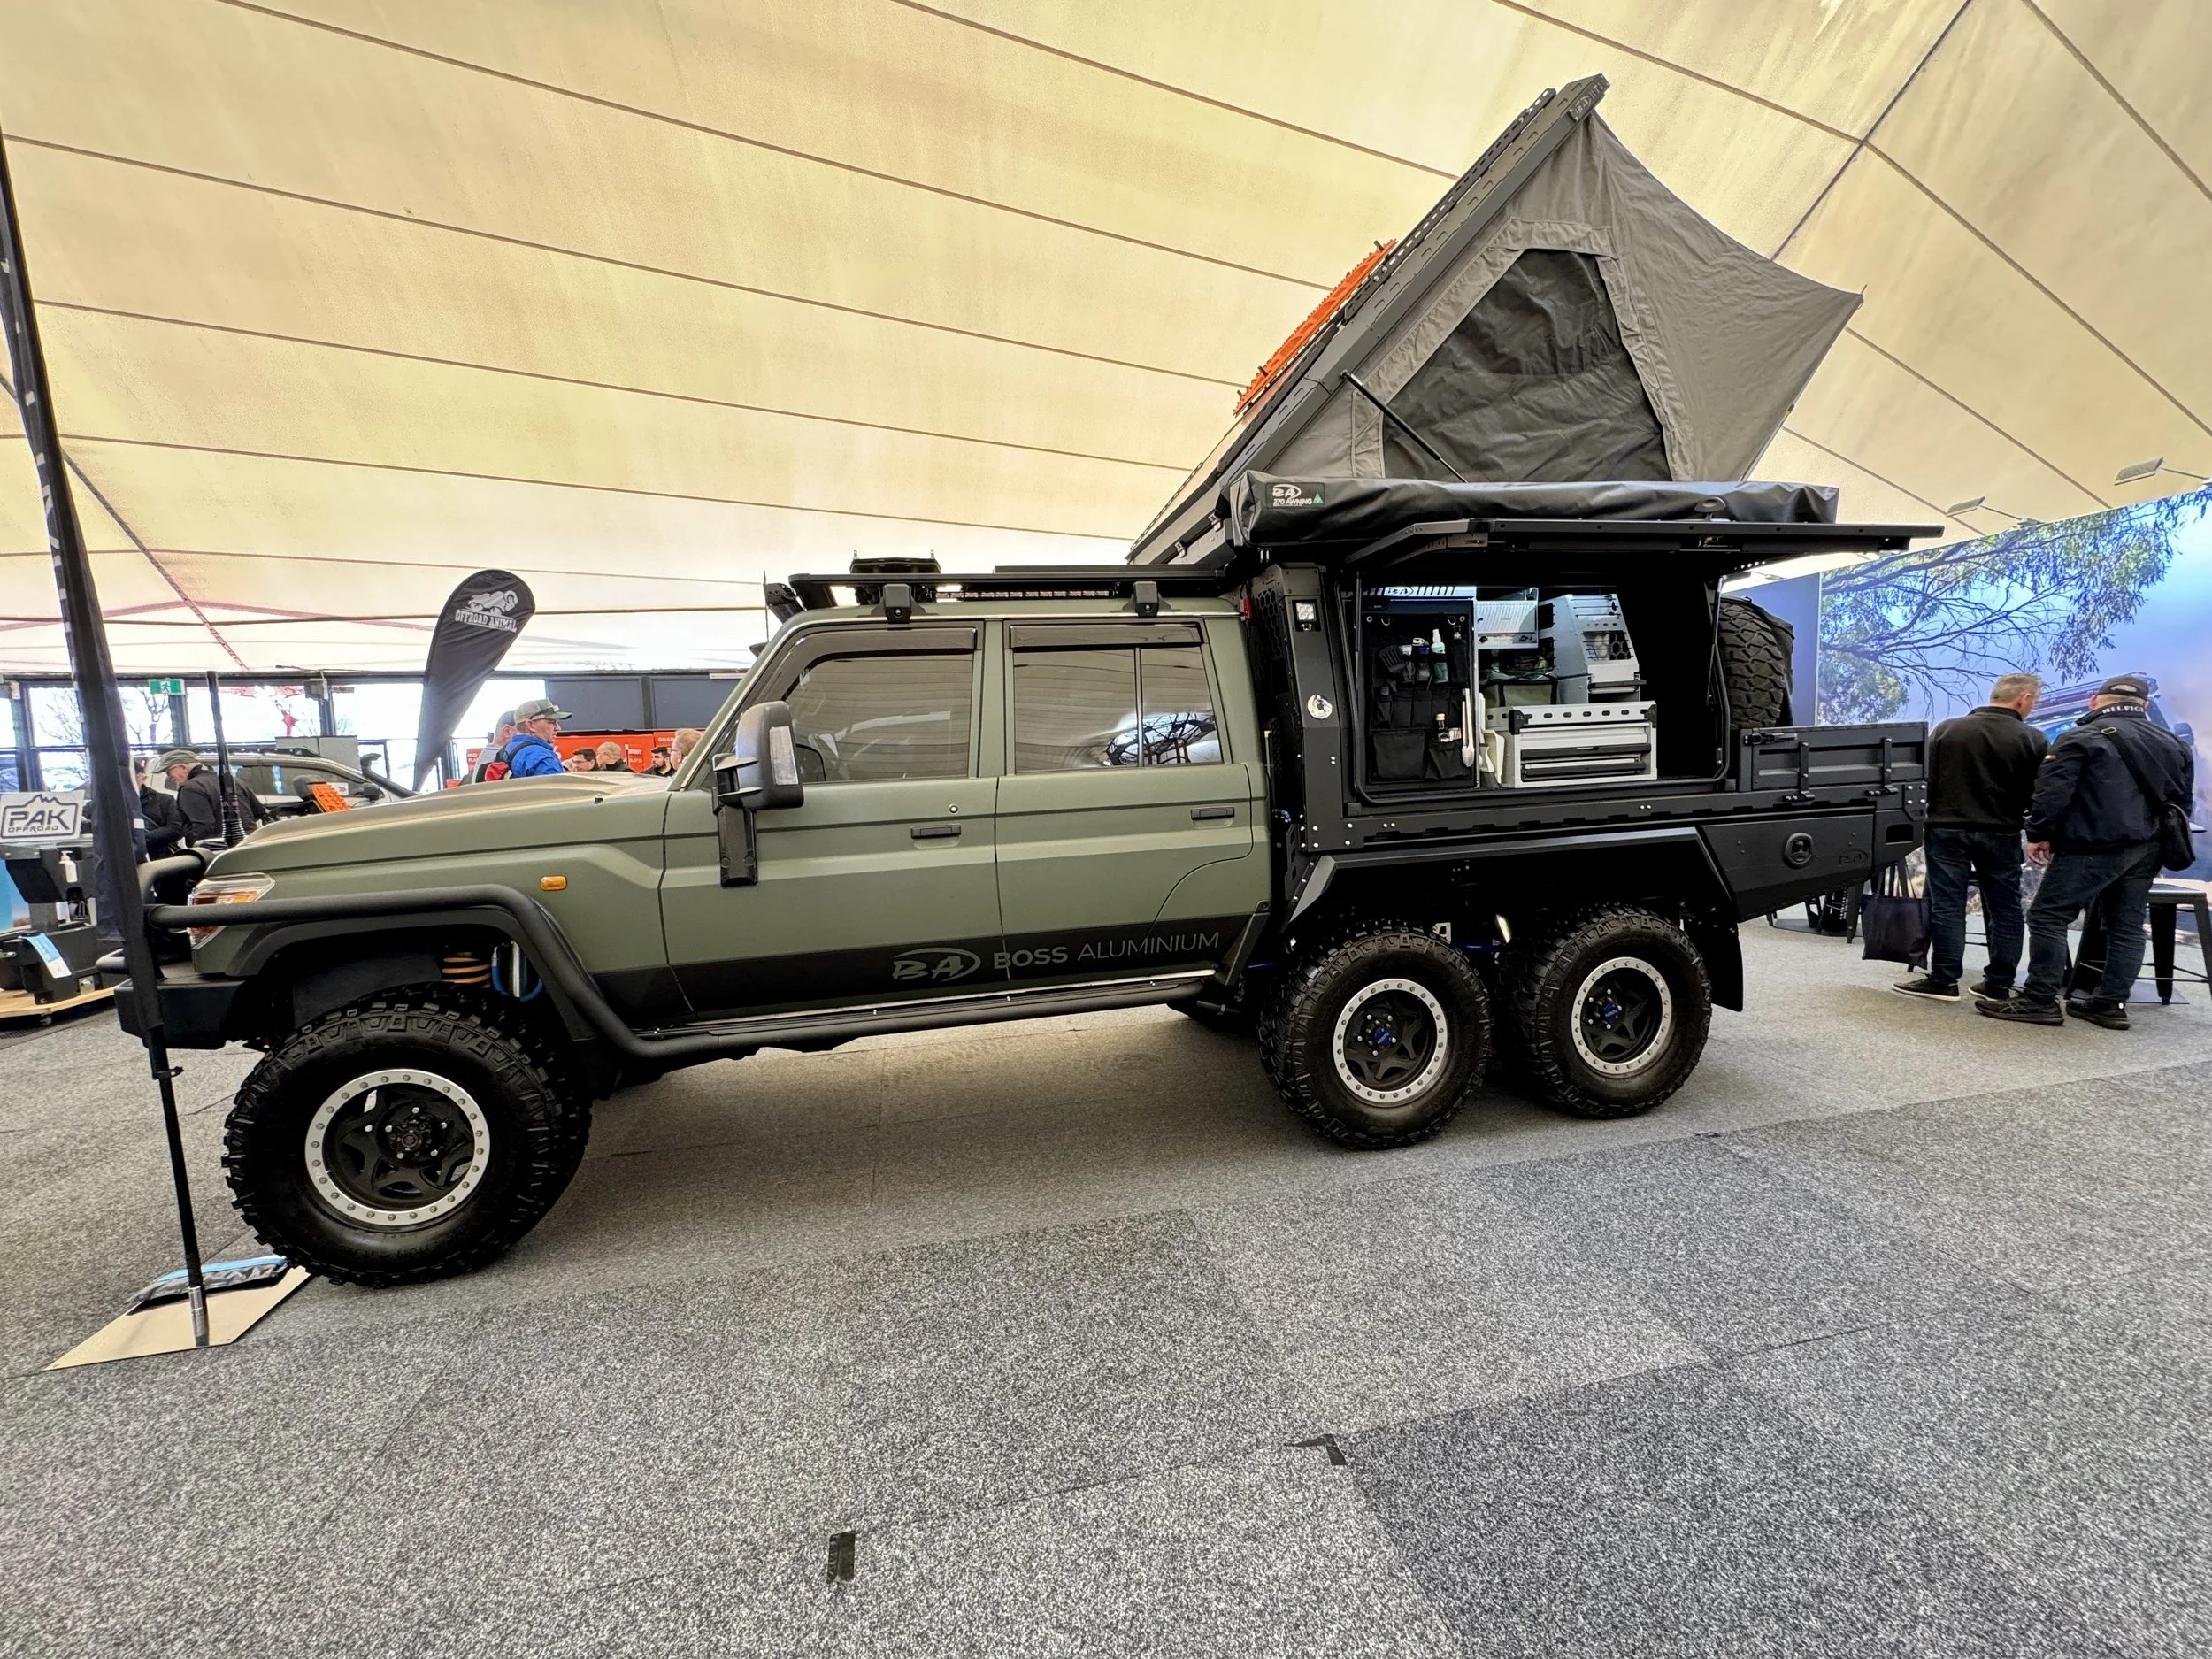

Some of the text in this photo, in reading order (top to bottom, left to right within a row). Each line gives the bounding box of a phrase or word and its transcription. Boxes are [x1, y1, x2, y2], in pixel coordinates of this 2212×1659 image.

[1272, 485, 1300, 498] BA
[455, 609, 518, 633] OFFROAD ANIMAL
[9, 809, 70, 830] PAK
[893, 932, 1219, 981] BA BOSS ALUMINIUM
